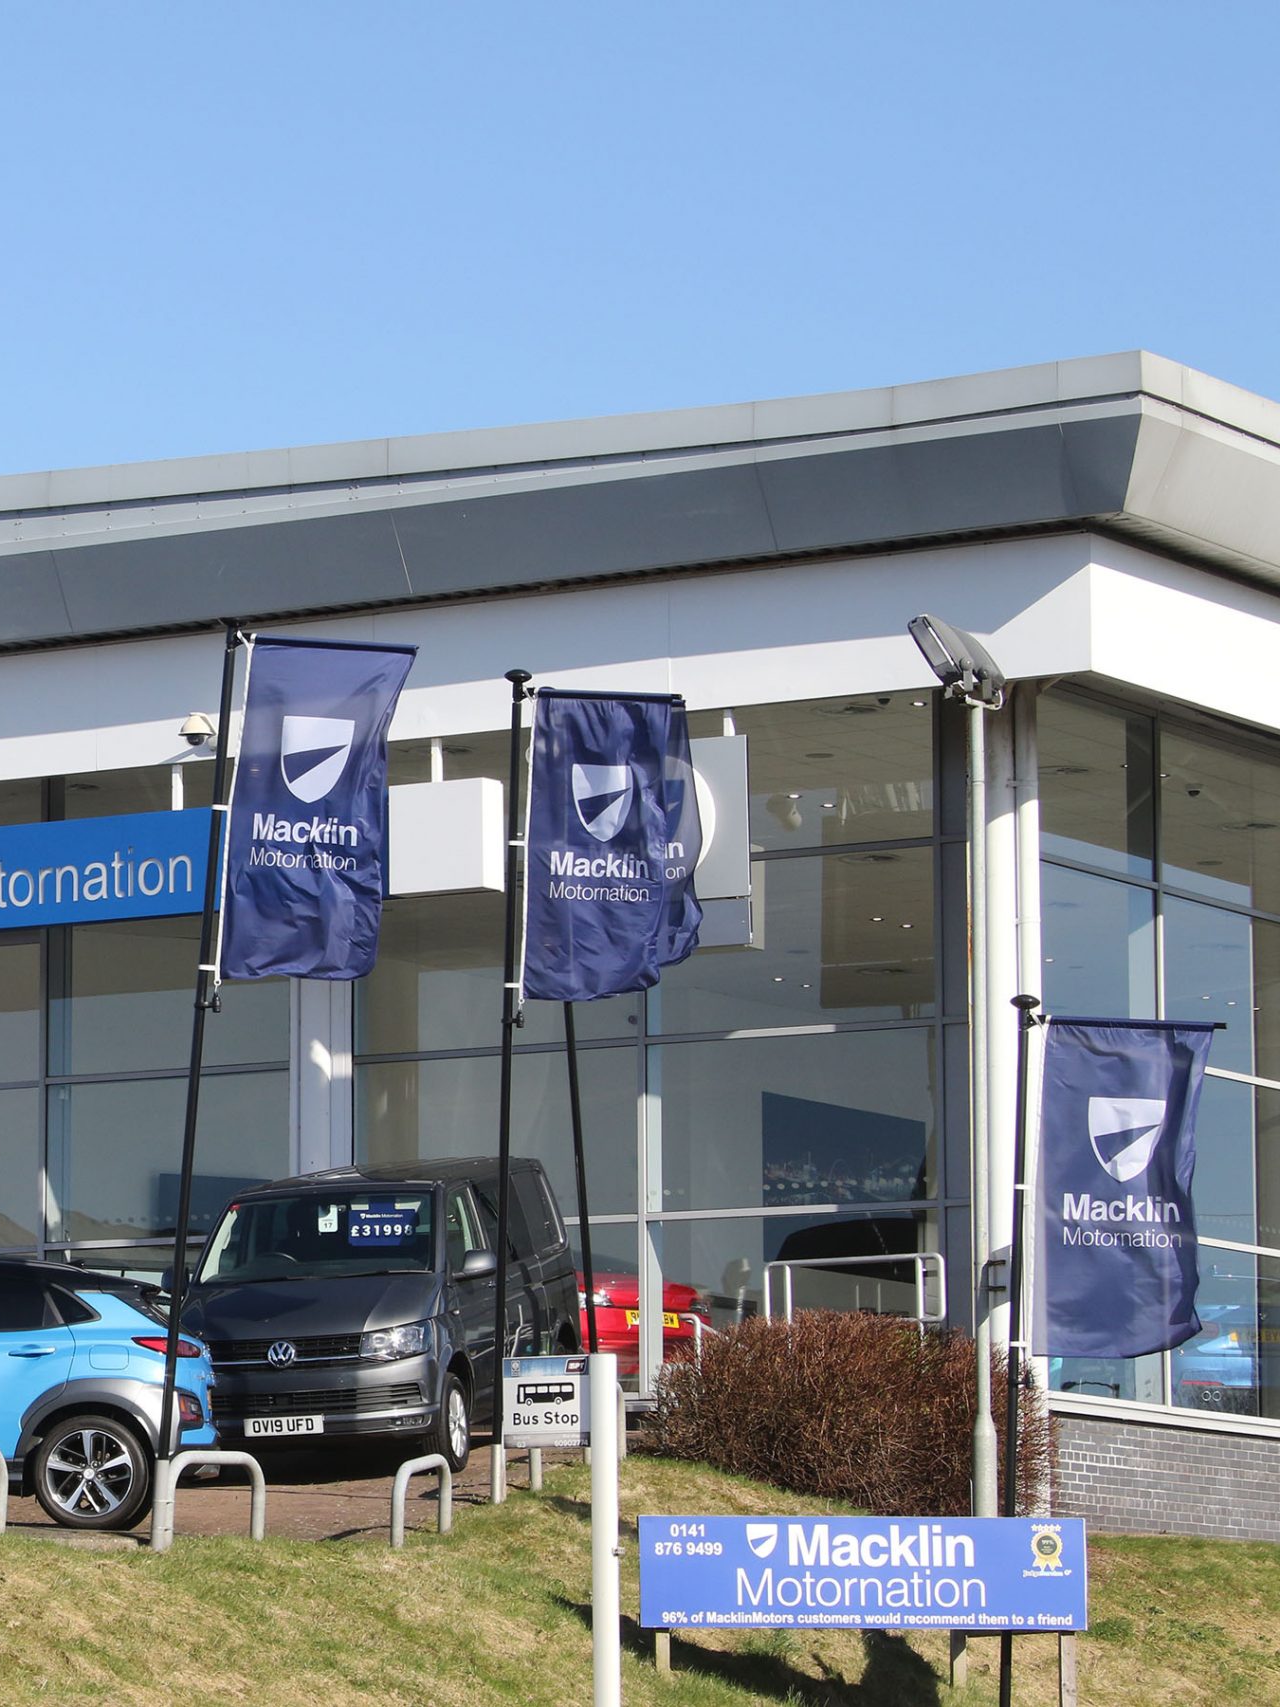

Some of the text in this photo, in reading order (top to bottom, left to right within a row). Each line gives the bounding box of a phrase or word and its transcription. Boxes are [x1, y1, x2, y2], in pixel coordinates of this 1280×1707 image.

[252, 813, 358, 846] Macklin
[249, 847, 357, 871] Motornation
[550, 851, 650, 879] Macklin
[549, 881, 650, 902] Motornation
[1063, 1193, 1180, 1223] Macklin
[1063, 1226, 1182, 1248] Motornation
[252, 1418, 314, 1433] OV19 UFD
[513, 1411, 579, 1426] Bus Stop
[670, 1524, 706, 1537] 0141
[655, 1542, 723, 1556] 876 9499
[788, 1524, 975, 1567] Macklin
[736, 1568, 986, 1607] Motornation
[662, 1611, 1073, 1626] 96% of MacklinMotors customers would recommend them to a friend
